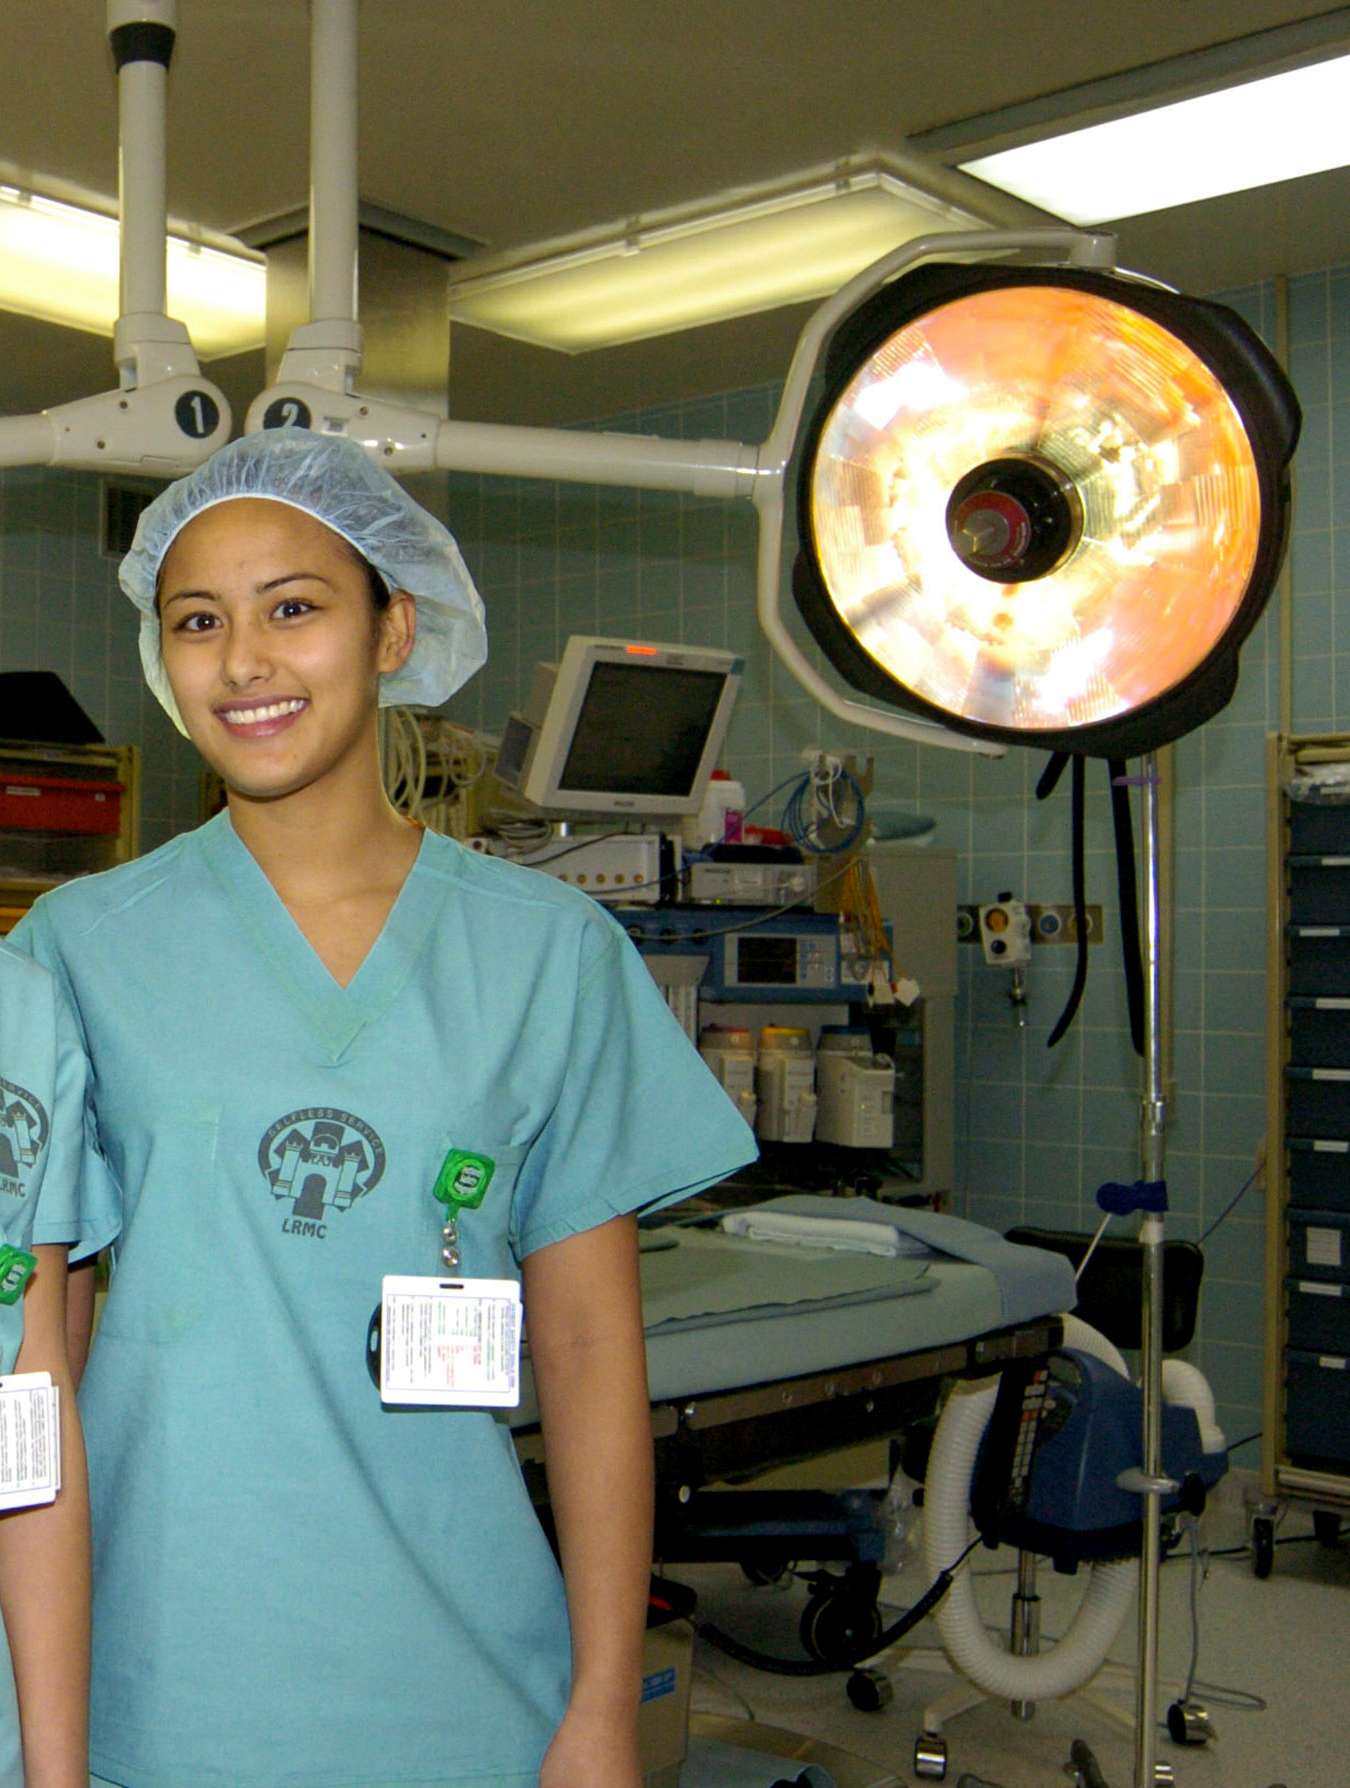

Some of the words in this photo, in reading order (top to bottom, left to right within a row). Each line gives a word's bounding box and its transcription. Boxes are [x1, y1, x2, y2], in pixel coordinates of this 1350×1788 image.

[191, 395, 205, 434] 1
[281, 402, 299, 428] 2
[268, 1108, 333, 1137] SELFLESS
[340, 1112, 383, 1156] SERVICE
[282, 1218, 328, 1240] LRMC
